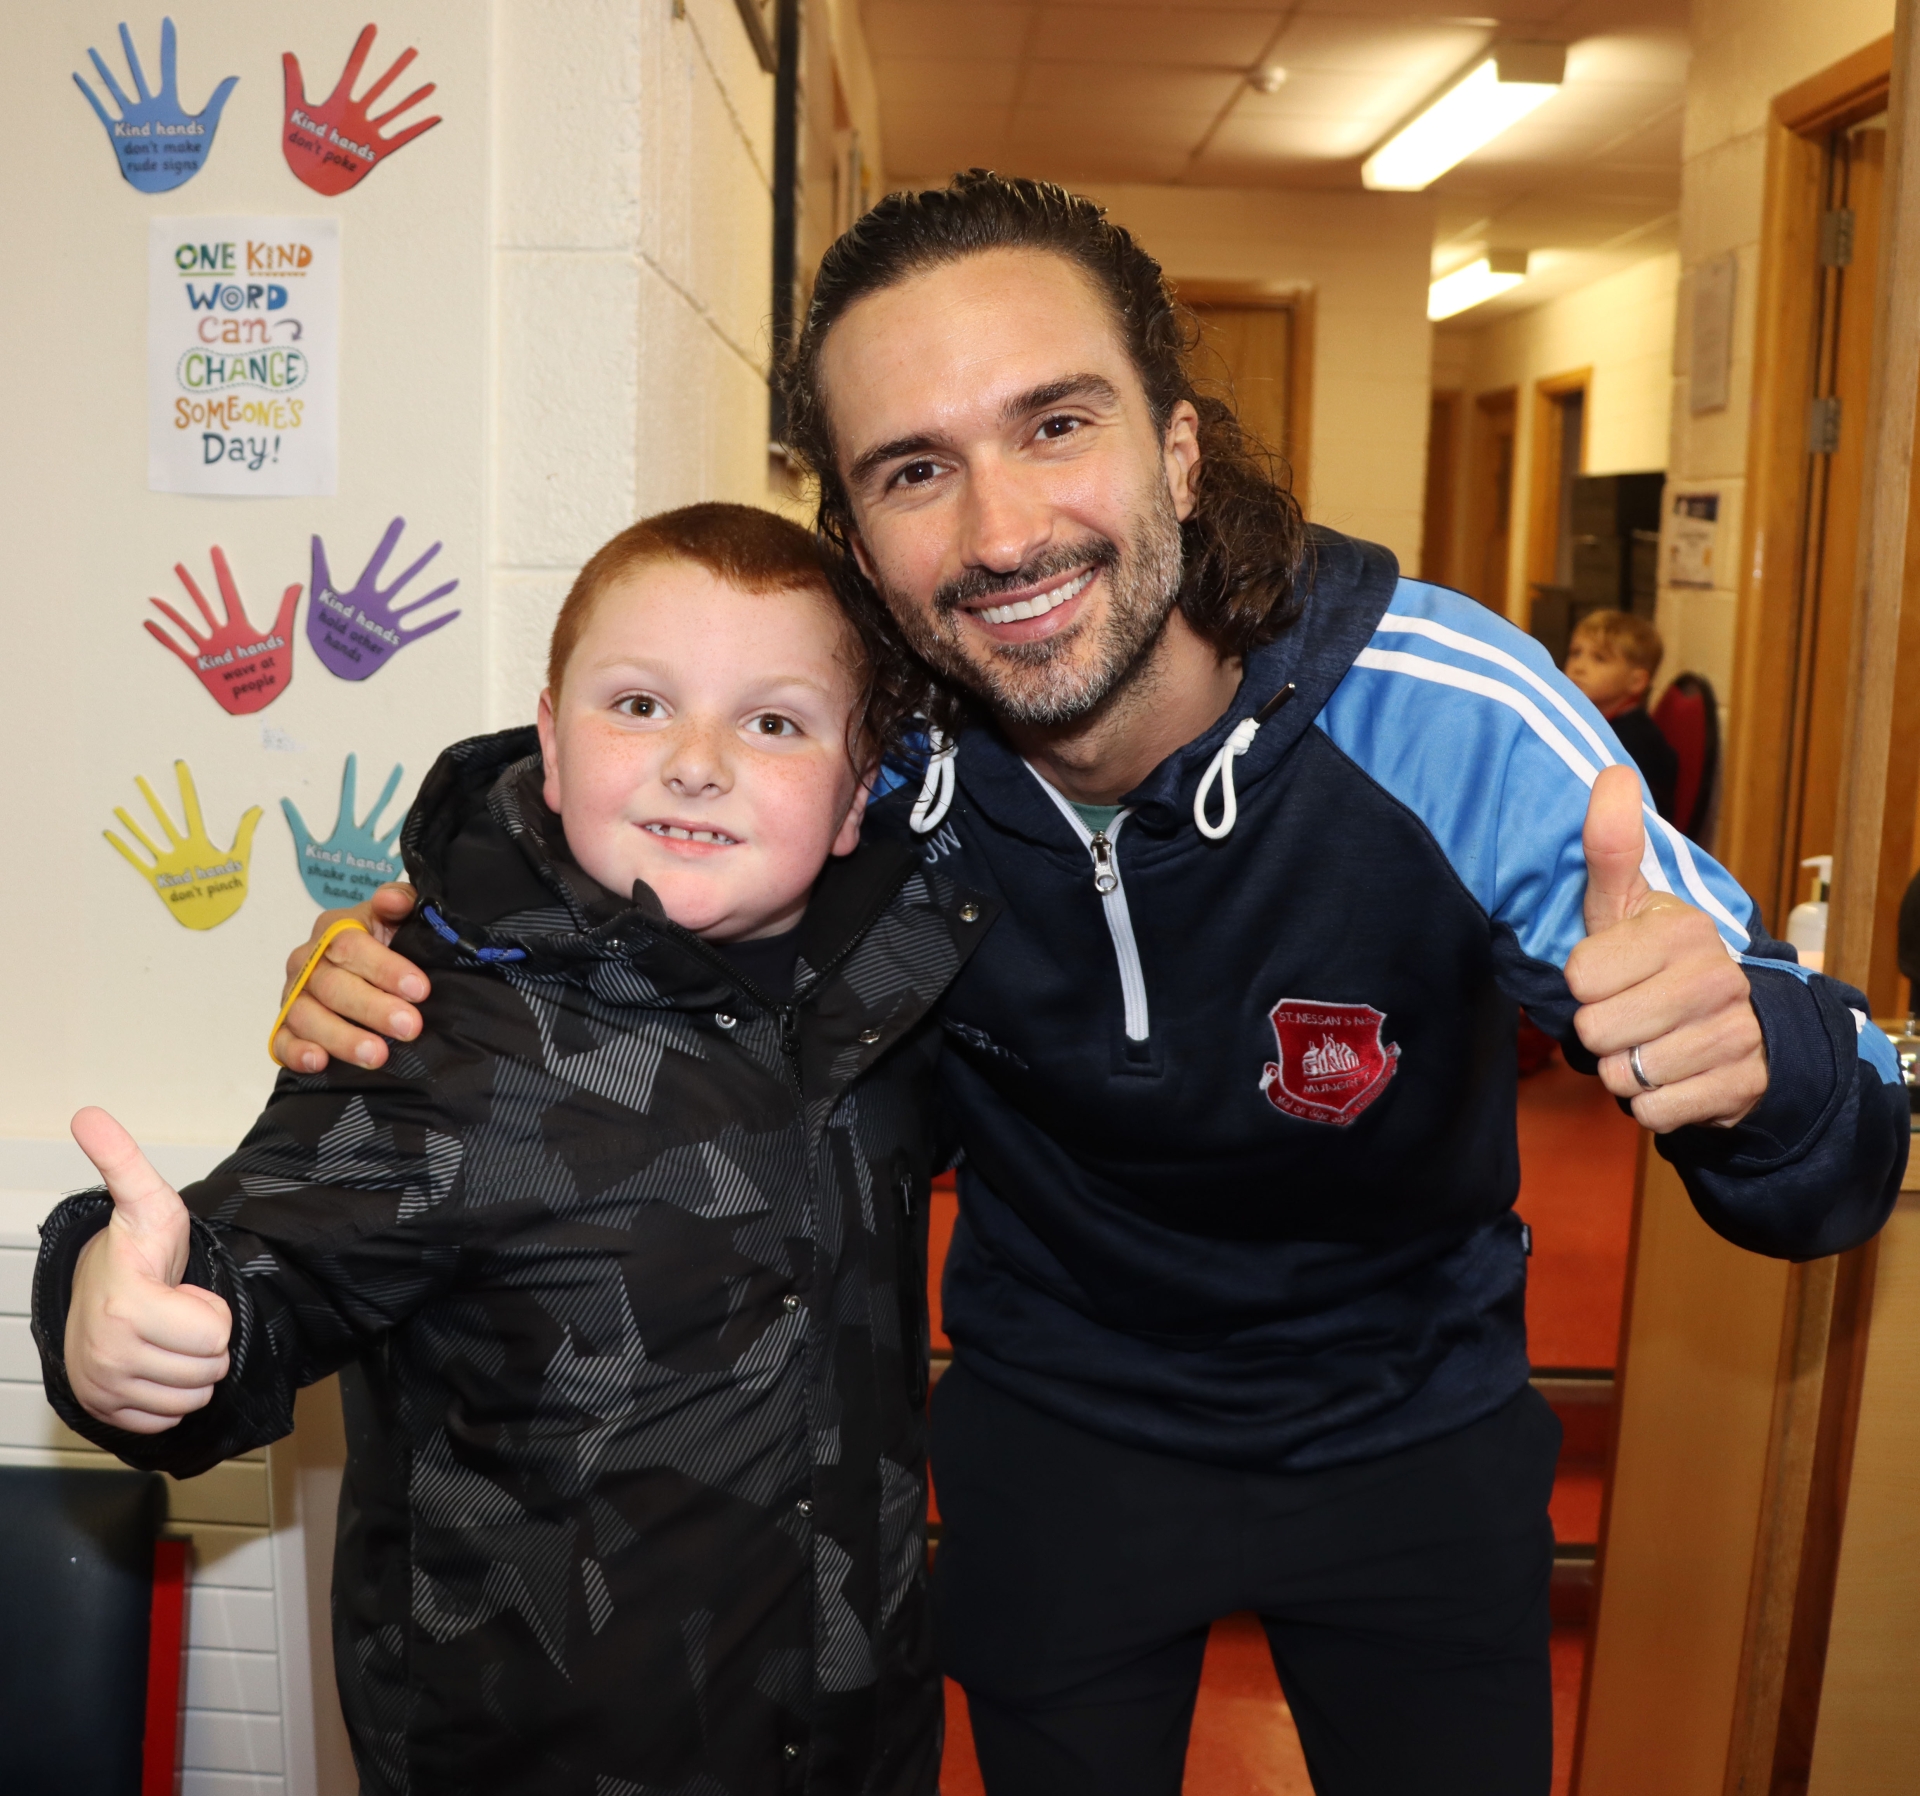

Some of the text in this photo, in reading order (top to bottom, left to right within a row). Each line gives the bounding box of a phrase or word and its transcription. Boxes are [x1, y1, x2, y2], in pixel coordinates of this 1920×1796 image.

[114, 121, 205, 137] Kind hands
[290, 108, 376, 162] Kind hands
[124, 140, 202, 156] don't make
[288, 130, 358, 174] don't poke
[126, 157, 199, 175] rude signs
[175, 242, 237, 270] ONE
[186, 283, 289, 312] WORD
[198, 316, 272, 344] can
[185, 351, 302, 387] CHANGE
[174, 395, 304, 431] SOMEONE'S
[202, 432, 280, 471] Day!
[318, 588, 401, 647] Kind hands
[318, 607, 385, 656] hold other
[197, 635, 285, 671] Kind hands
[323, 632, 363, 664] hands
[223, 655, 276, 681] wave at
[232, 673, 277, 699] people
[925, 821, 962, 864] JW
[305, 843, 394, 874] Kind hands
[307, 864, 346, 882] shake
[155, 859, 243, 889] Kind hands
[170, 878, 243, 902] don't pinch
[322, 881, 365, 902] hands
